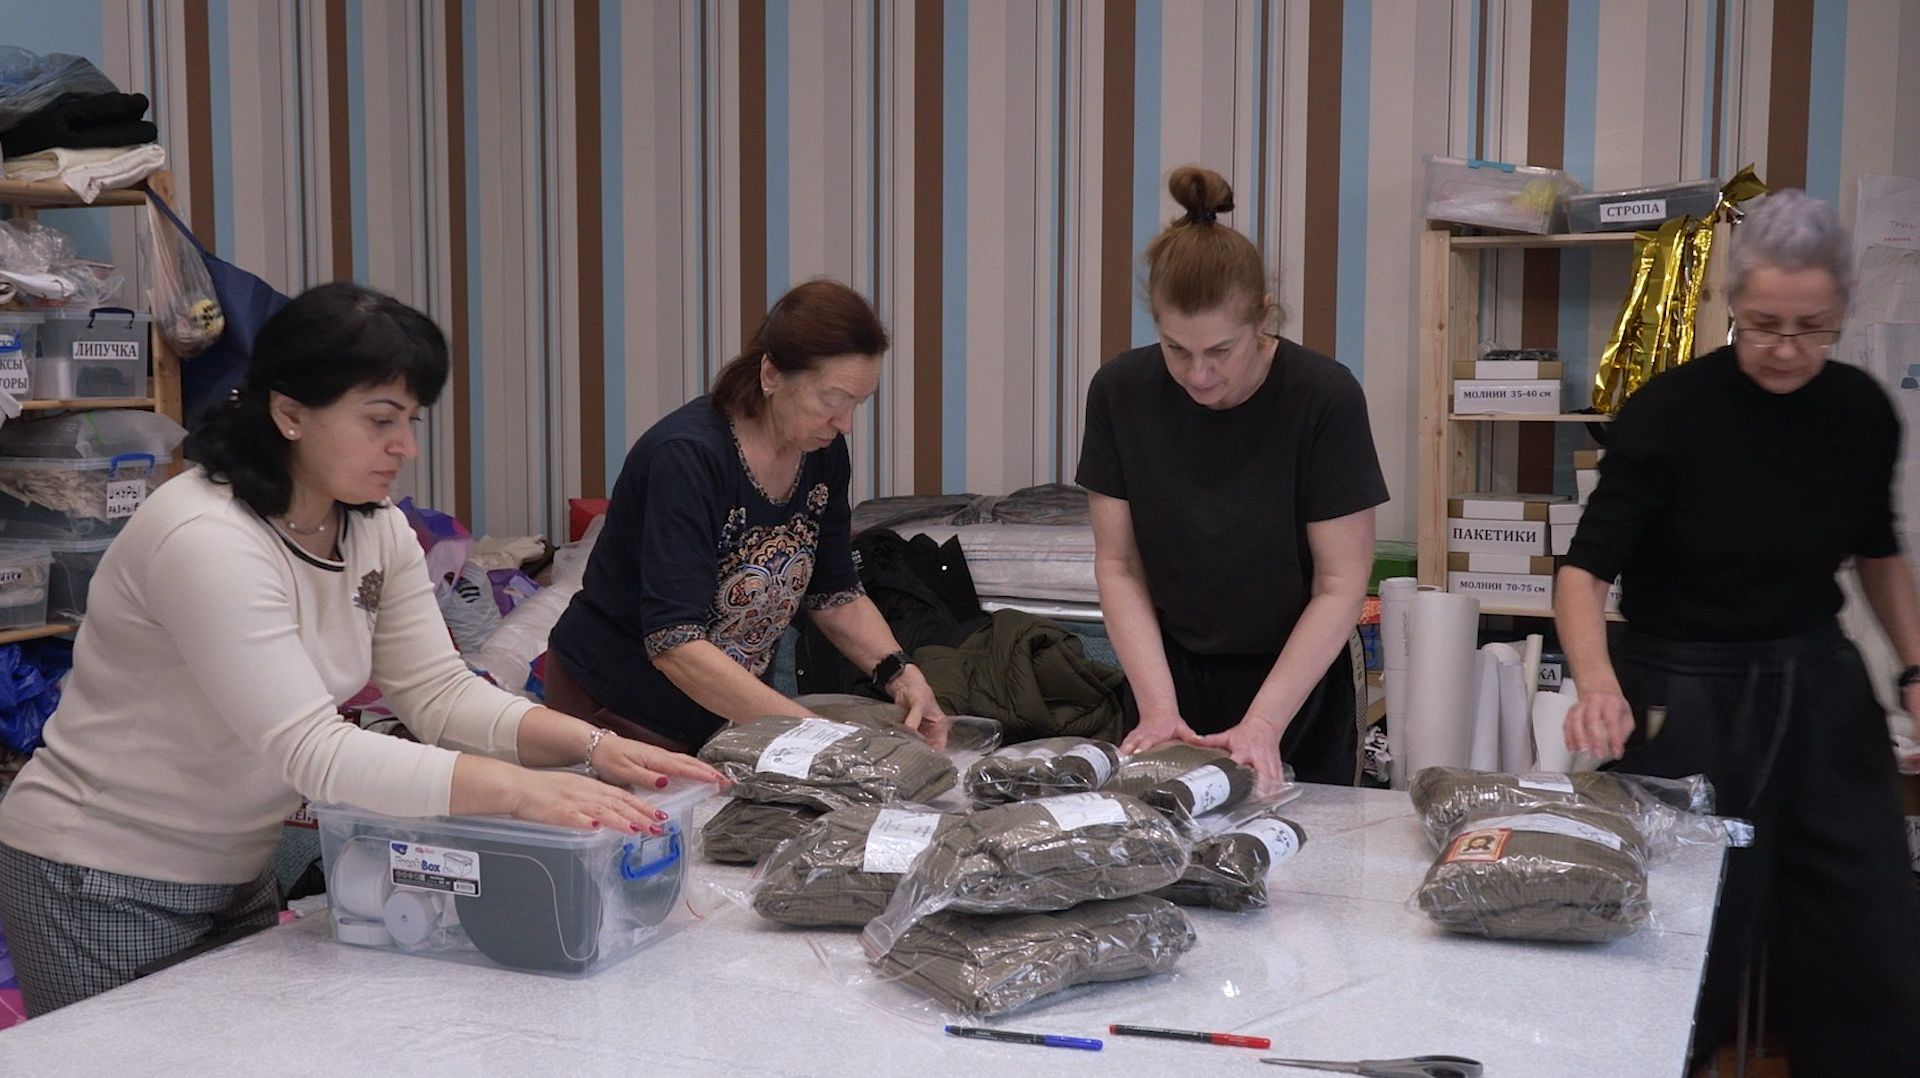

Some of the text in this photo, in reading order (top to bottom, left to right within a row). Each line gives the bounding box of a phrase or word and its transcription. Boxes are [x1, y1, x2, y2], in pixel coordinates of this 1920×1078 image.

[1606, 204, 1660, 217] СТРОПА
[74, 342, 139, 357] ЛИПУЧКА
[1463, 390, 1552, 400] МОЛНИИ 35-40 см
[1452, 527, 1536, 543] ПАКЕТИКИ
[1459, 580, 1546, 593] МОЛНИИ 70-75 см
[421, 860, 440, 872] Box
